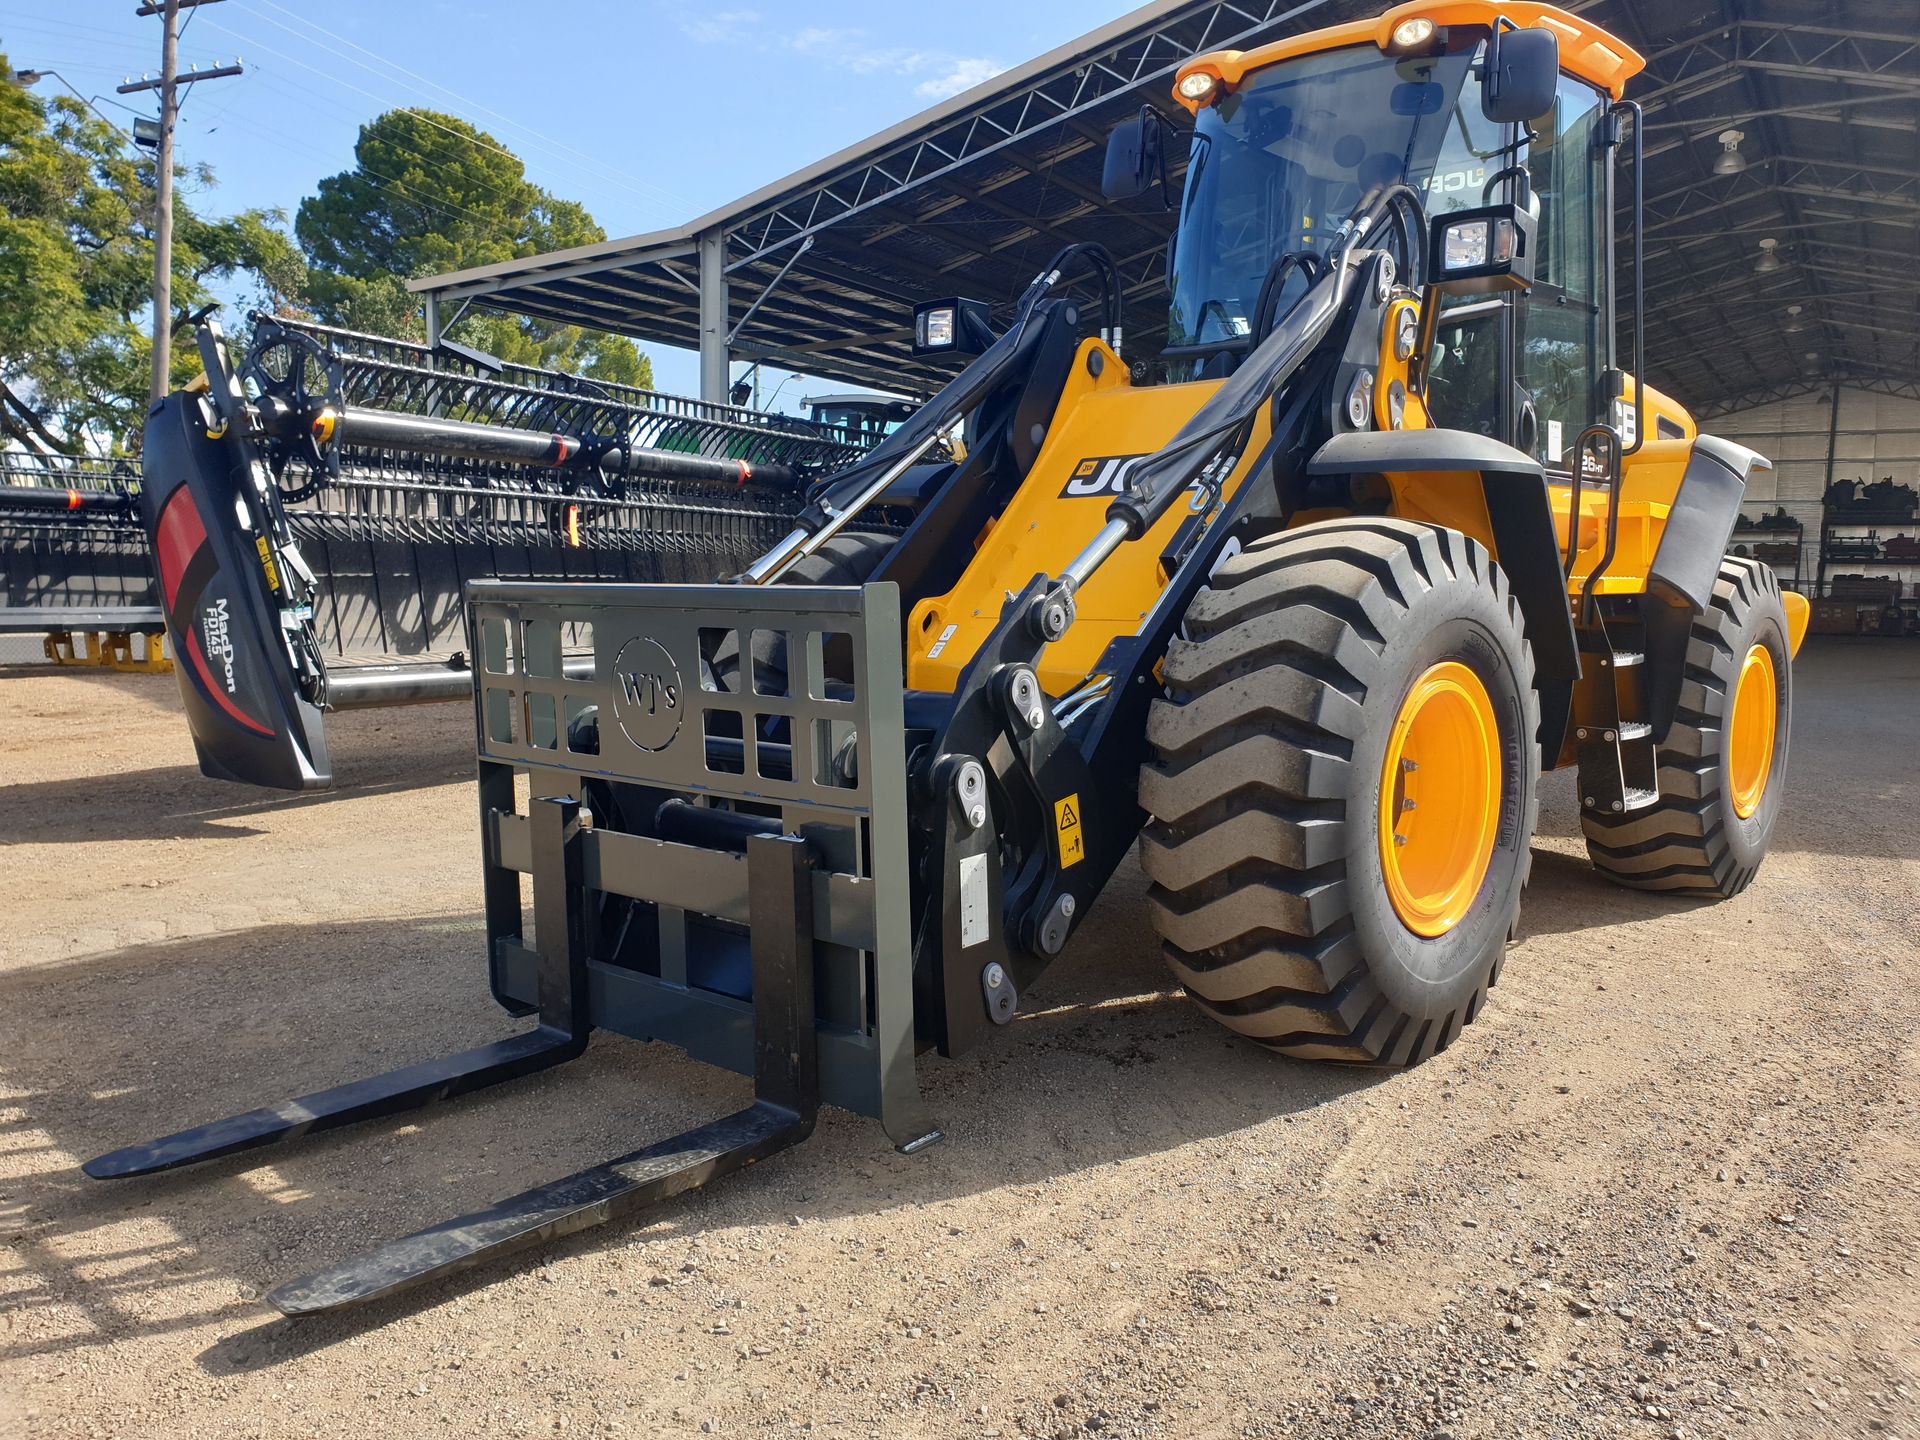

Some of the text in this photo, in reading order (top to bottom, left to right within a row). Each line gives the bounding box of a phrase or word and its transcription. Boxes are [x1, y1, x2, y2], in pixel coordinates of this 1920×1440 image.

[1571, 455, 1603, 473] 26HT
[206, 607, 222, 655] FD145
[216, 599, 235, 693] MacDon
